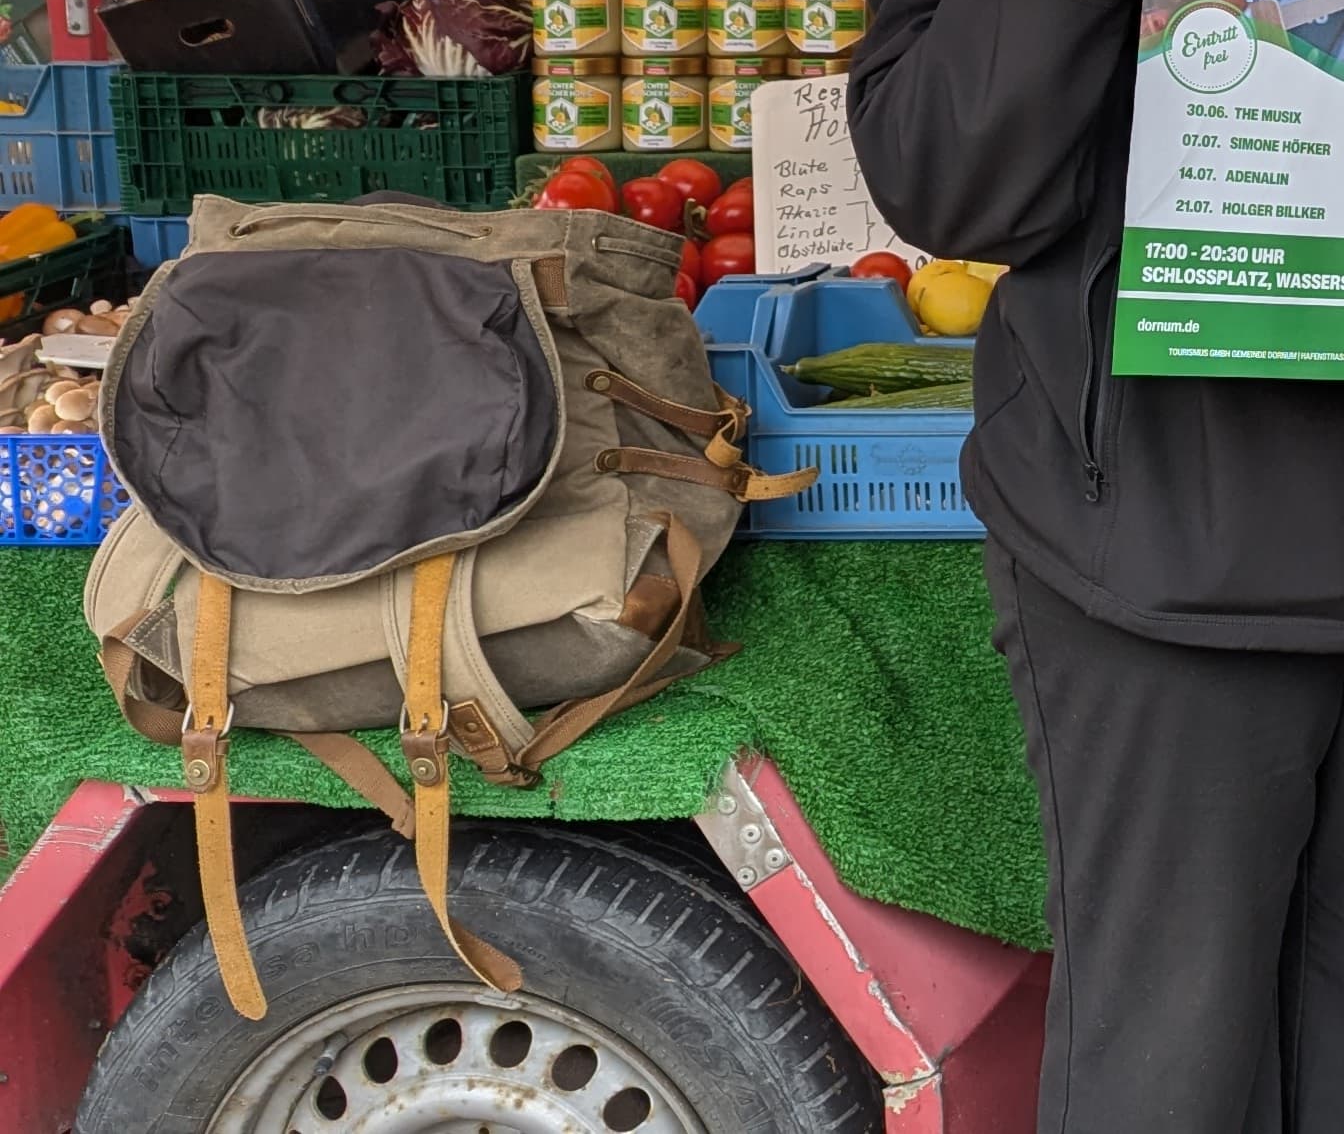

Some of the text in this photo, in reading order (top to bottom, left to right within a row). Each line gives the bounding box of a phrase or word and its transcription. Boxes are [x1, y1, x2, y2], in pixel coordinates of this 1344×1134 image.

[1182, 26, 1239, 57] Eintritt
[1203, 50, 1229, 70] frei
[793, 83, 849, 111] Reg
[1187, 104, 1302, 124] 30.06. THE MUSIX
[1182, 134, 1331, 156] 07.07. SIMONE HÖFKER
[1179, 166, 1289, 185] 14.07. ADENALIN
[780, 183, 832, 201] Raps
[776, 204, 837, 220] Akazie
[1176, 199, 1325, 220] 21.07. HOLGER BILLKER
[777, 221, 837, 239] Linde
[777, 240, 854, 258] Obstblüte
[1145, 242, 1188, 260] 17:00
[1200, 245, 1248, 263] 20:30
[1251, 248, 1285, 264] UHR
[1141, 266, 1273, 291] SCHLOSSPLATZ,
[1137, 318, 1200, 333] dornum.de
[1168, 348, 1208, 357] TOURISMUS
[1210, 349, 1231, 358] GMBH
[1232, 350, 1266, 359] GEMEINDE
[1267, 351, 1297, 360] DORNUM
